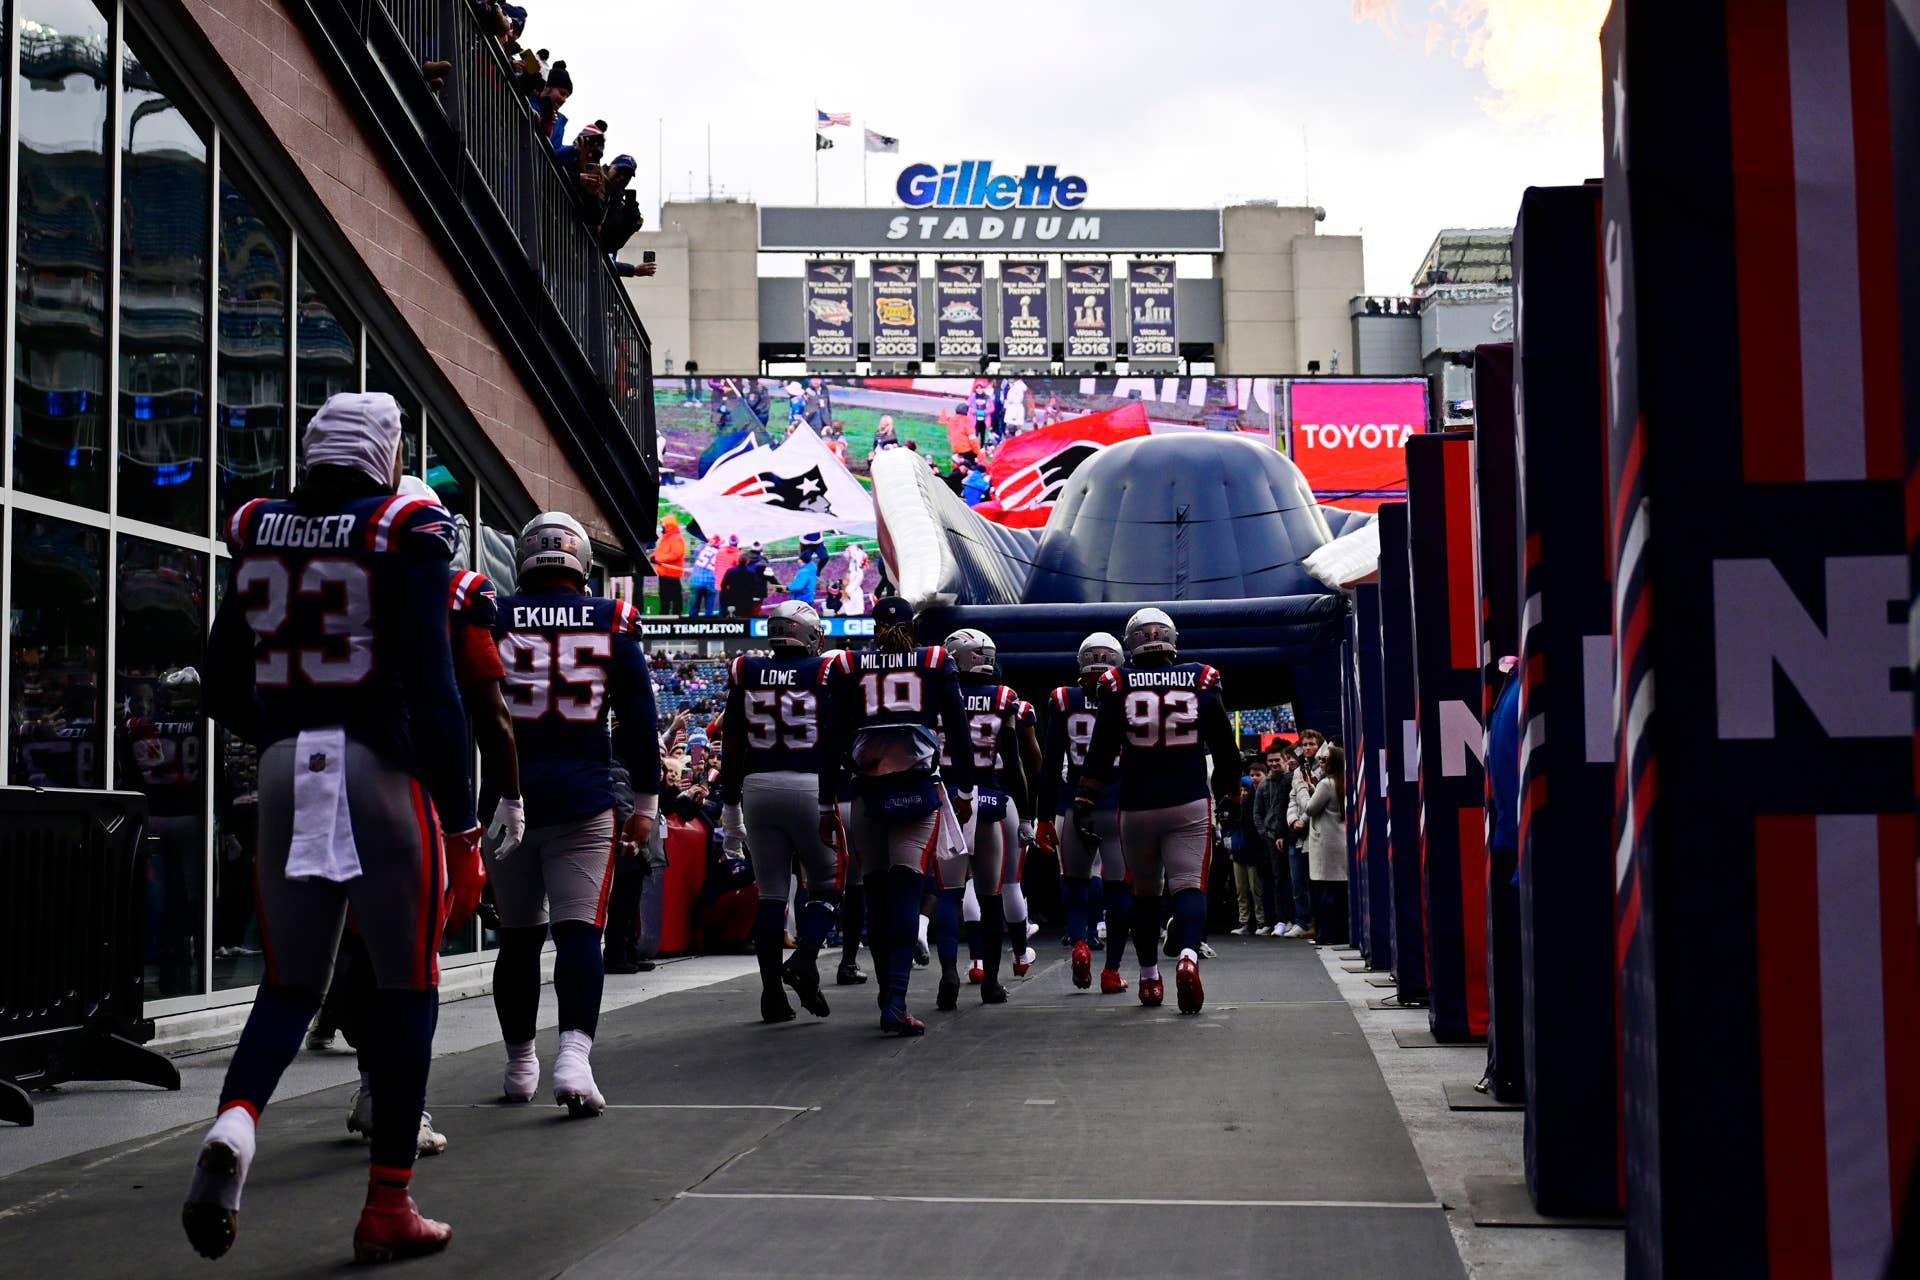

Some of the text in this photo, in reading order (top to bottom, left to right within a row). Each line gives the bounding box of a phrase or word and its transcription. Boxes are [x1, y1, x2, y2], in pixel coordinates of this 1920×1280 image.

[896, 160, 1088, 208] Gillette
[886, 216, 1100, 240] STADIUM
[817, 329, 844, 337] WORLD
[882, 329, 909, 337] WORLD
[947, 329, 974, 337] WORLD
[1012, 329, 1039, 337] WORLD
[1076, 329, 1103, 337] WORLD
[1140, 329, 1167, 337] WORLD
[812, 344, 850, 355] 2001
[876, 344, 916, 355] 2003
[941, 344, 982, 355] 2004
[1008, 344, 1045, 355] 2014
[1072, 344, 1108, 355] 2016
[1135, 344, 1172, 355] 2018
[1300, 424, 1415, 448] TOYOTA
[256, 513, 356, 548] DUGGER
[541, 537, 562, 549] 95
[536, 556, 565, 565] PATRIOTS
[236, 558, 373, 685] 23
[513, 606, 595, 627] EKUALE
[641, 624, 671, 634] KLIN
[673, 623, 744, 634] TEMPLETON
[1712, 555, 1914, 739] NE
[860, 652, 917, 669] MILTON III
[499, 633, 611, 720] 95
[760, 669, 797, 686] LOWE
[1128, 672, 1196, 687] GODCHAUX
[964, 696, 991, 711] DEN
[744, 690, 818, 750] 59
[1125, 690, 1199, 747] 92
